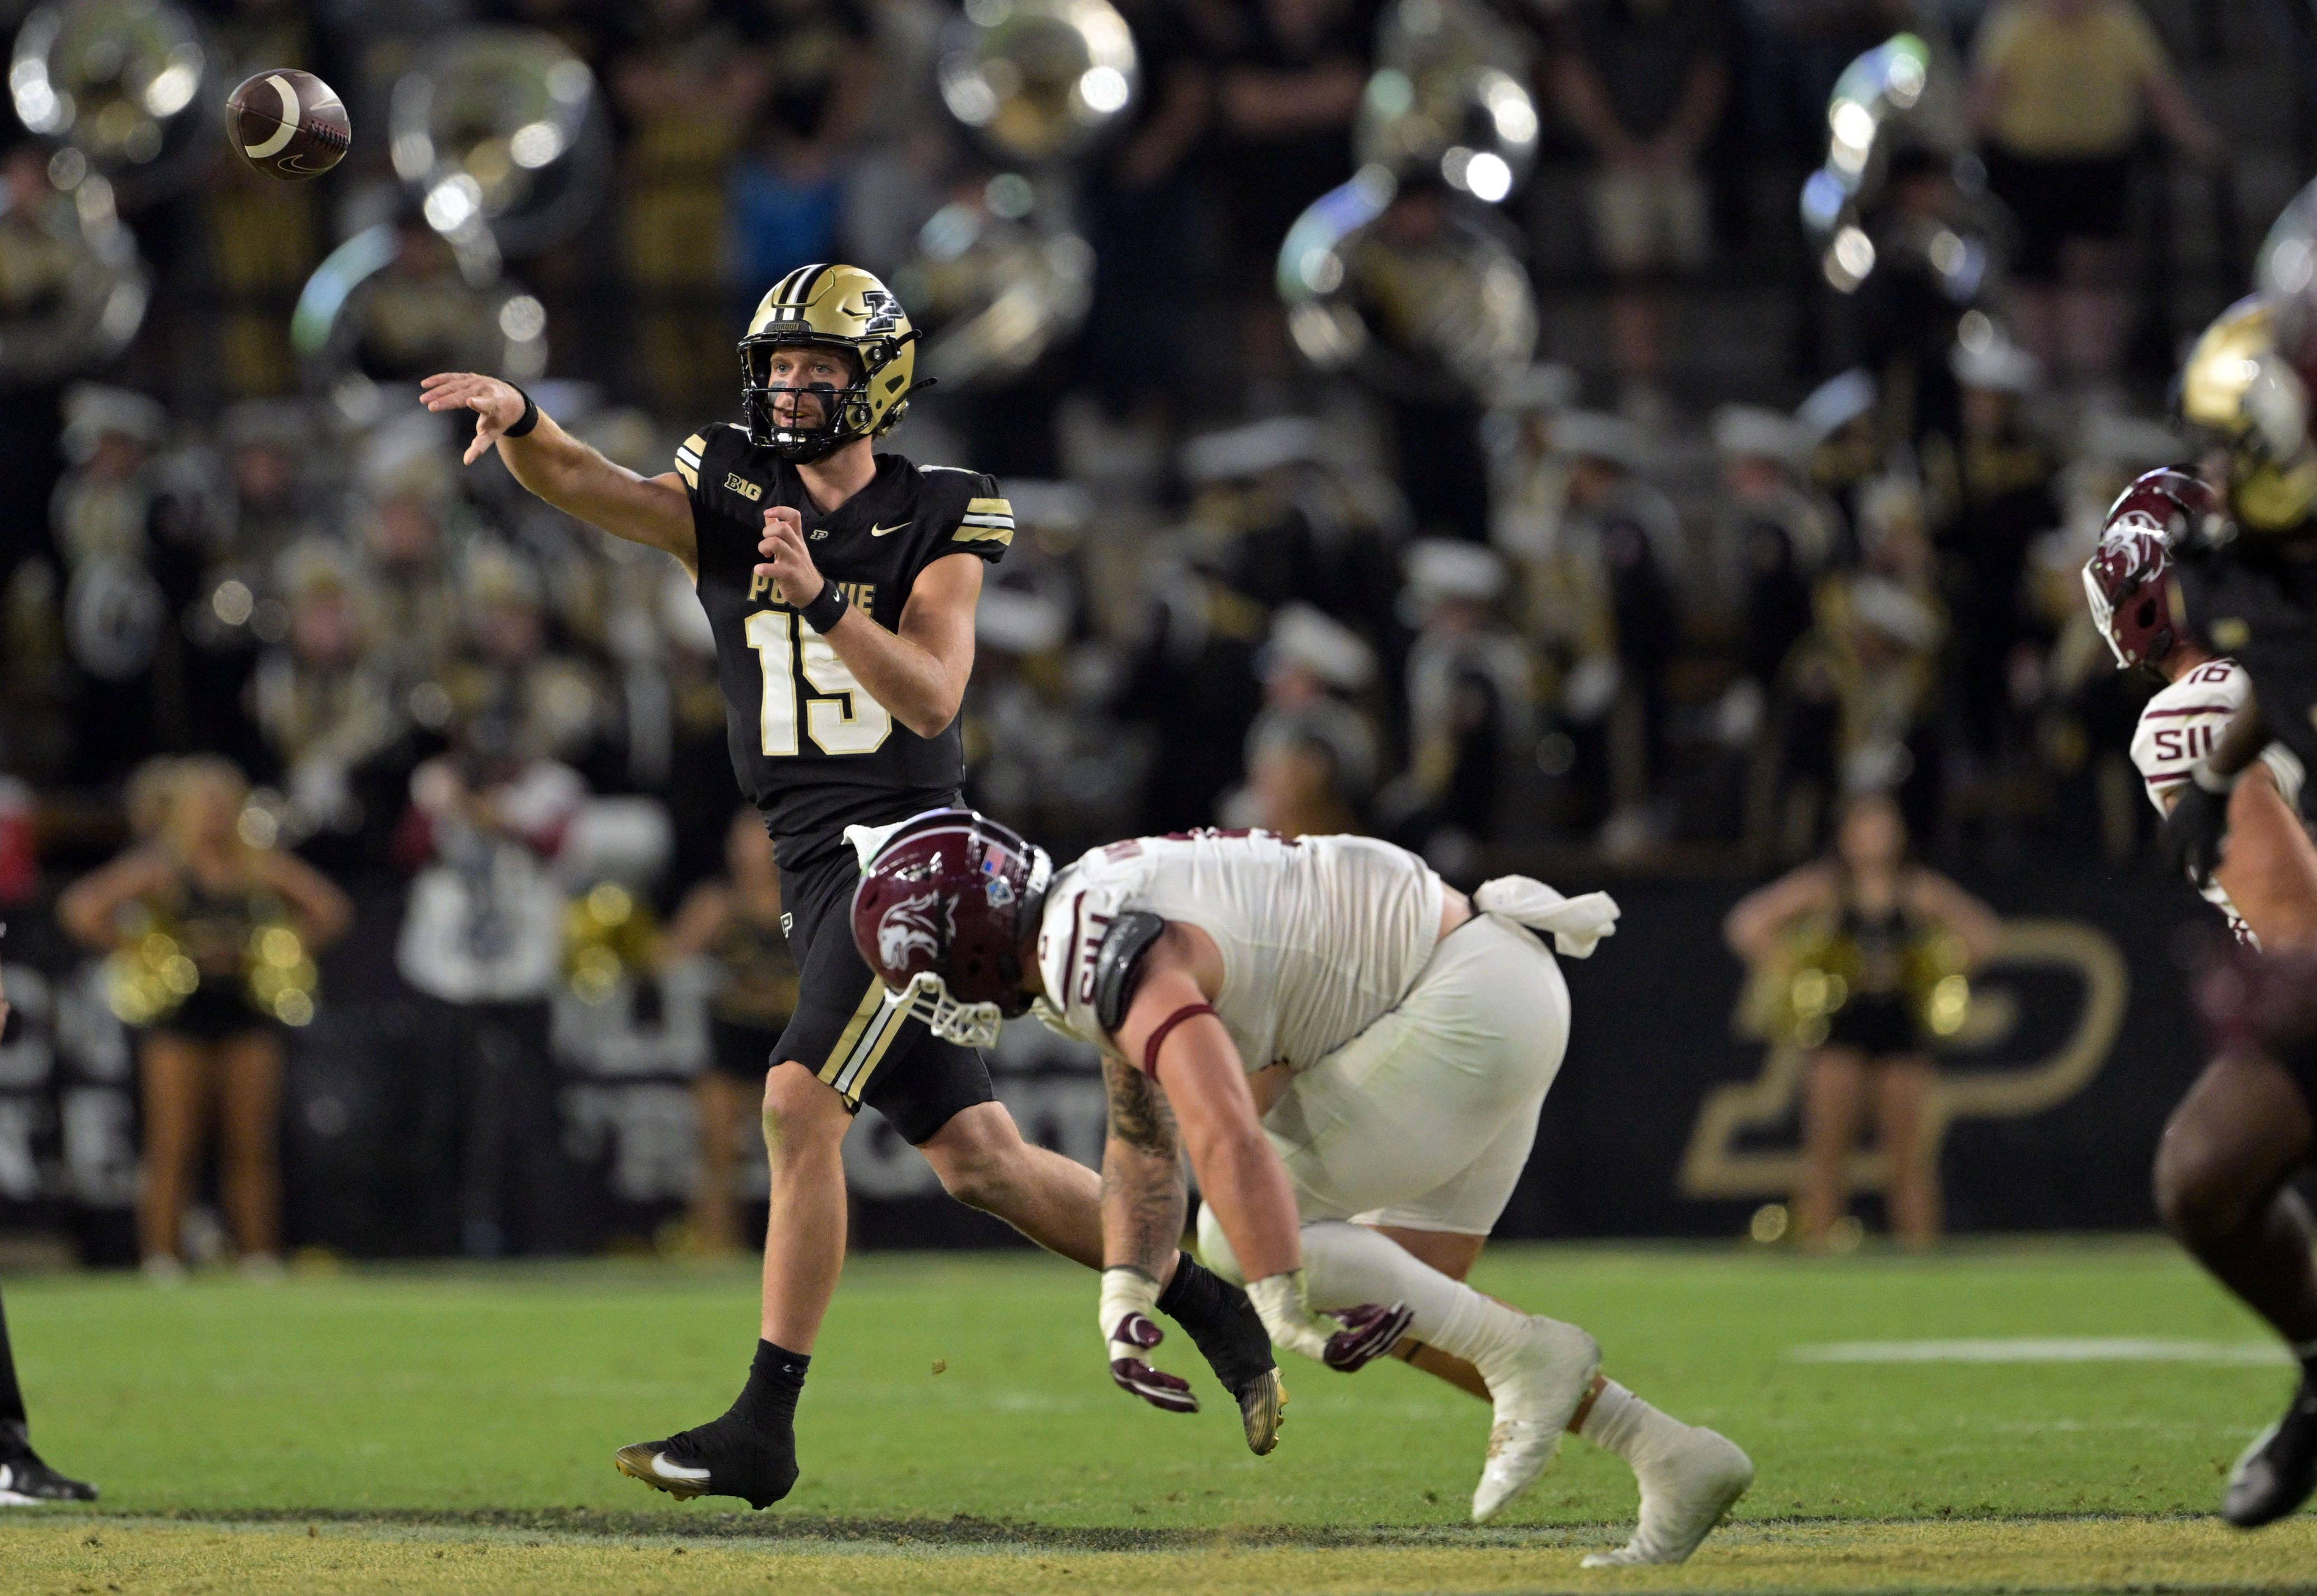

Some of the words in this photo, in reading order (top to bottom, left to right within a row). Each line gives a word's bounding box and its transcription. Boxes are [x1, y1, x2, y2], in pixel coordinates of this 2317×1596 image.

[772, 322, 799, 331] PURDUE
[810, 529, 829, 540] P
[746, 572, 877, 617] PUUE
[745, 610, 893, 756] 15
